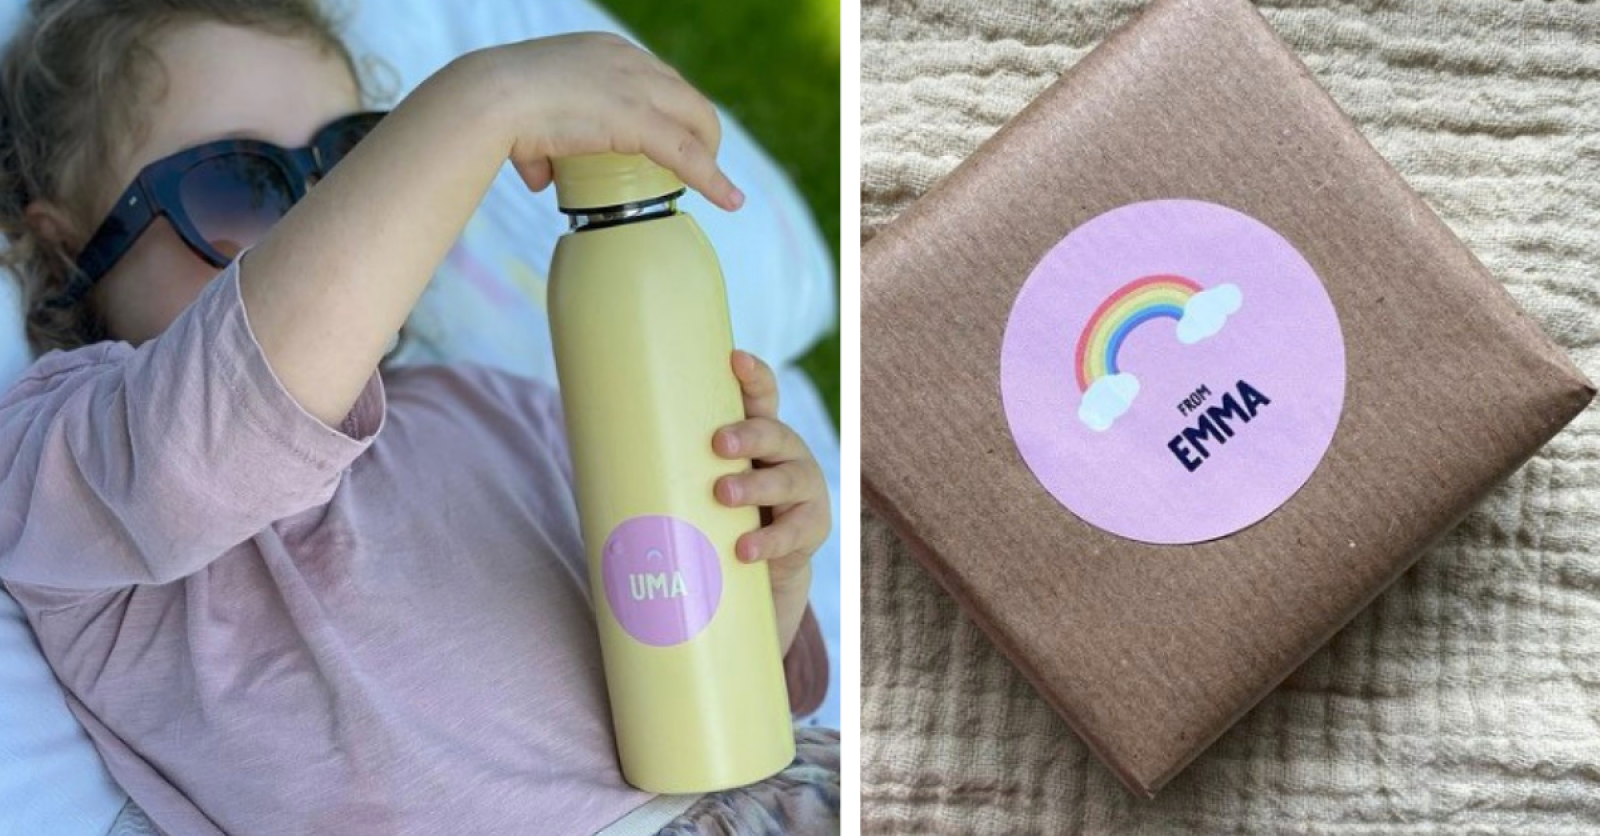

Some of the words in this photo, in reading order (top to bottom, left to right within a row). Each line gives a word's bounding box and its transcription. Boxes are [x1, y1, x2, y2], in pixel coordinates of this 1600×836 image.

[1177, 384, 1212, 417] FROM
[1167, 380, 1271, 472] EMMA
[629, 571, 688, 600] UMA
